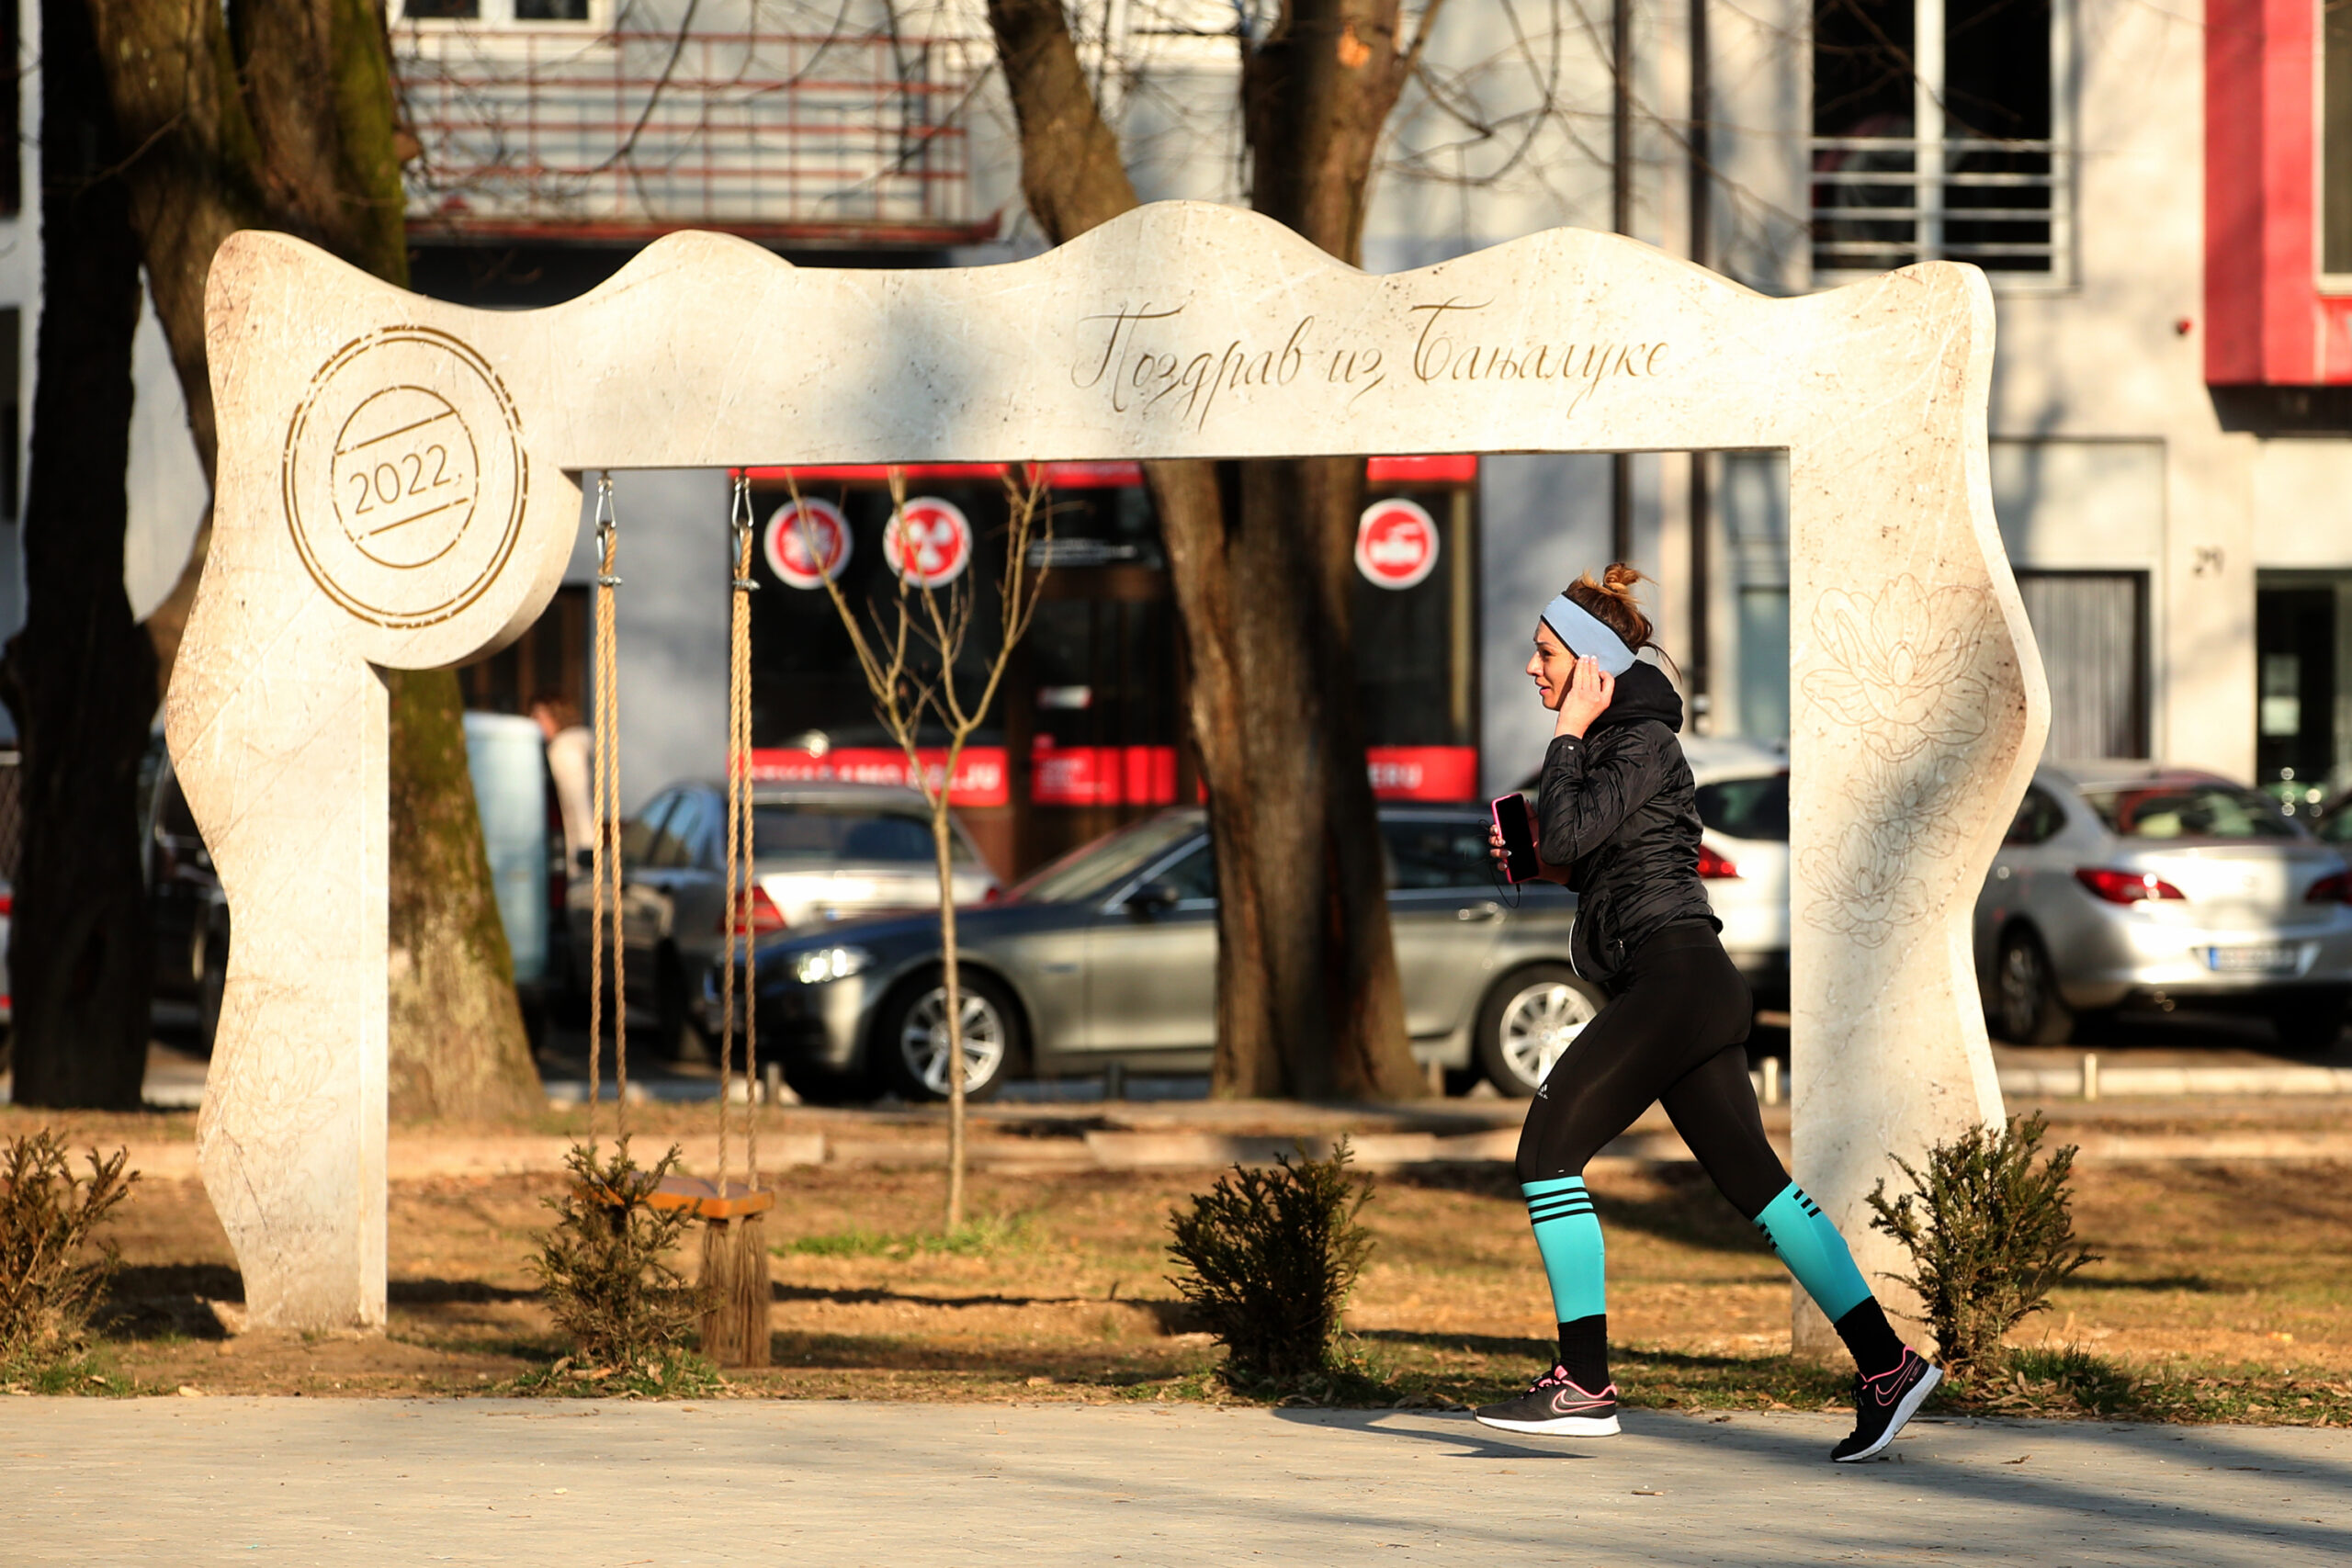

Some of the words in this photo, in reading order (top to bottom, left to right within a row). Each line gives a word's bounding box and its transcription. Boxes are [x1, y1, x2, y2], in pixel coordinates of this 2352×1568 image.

[1070, 302, 1315, 434] Поздрав
[1329, 348, 1385, 413] из
[1408, 295, 1668, 419] Бањалуке
